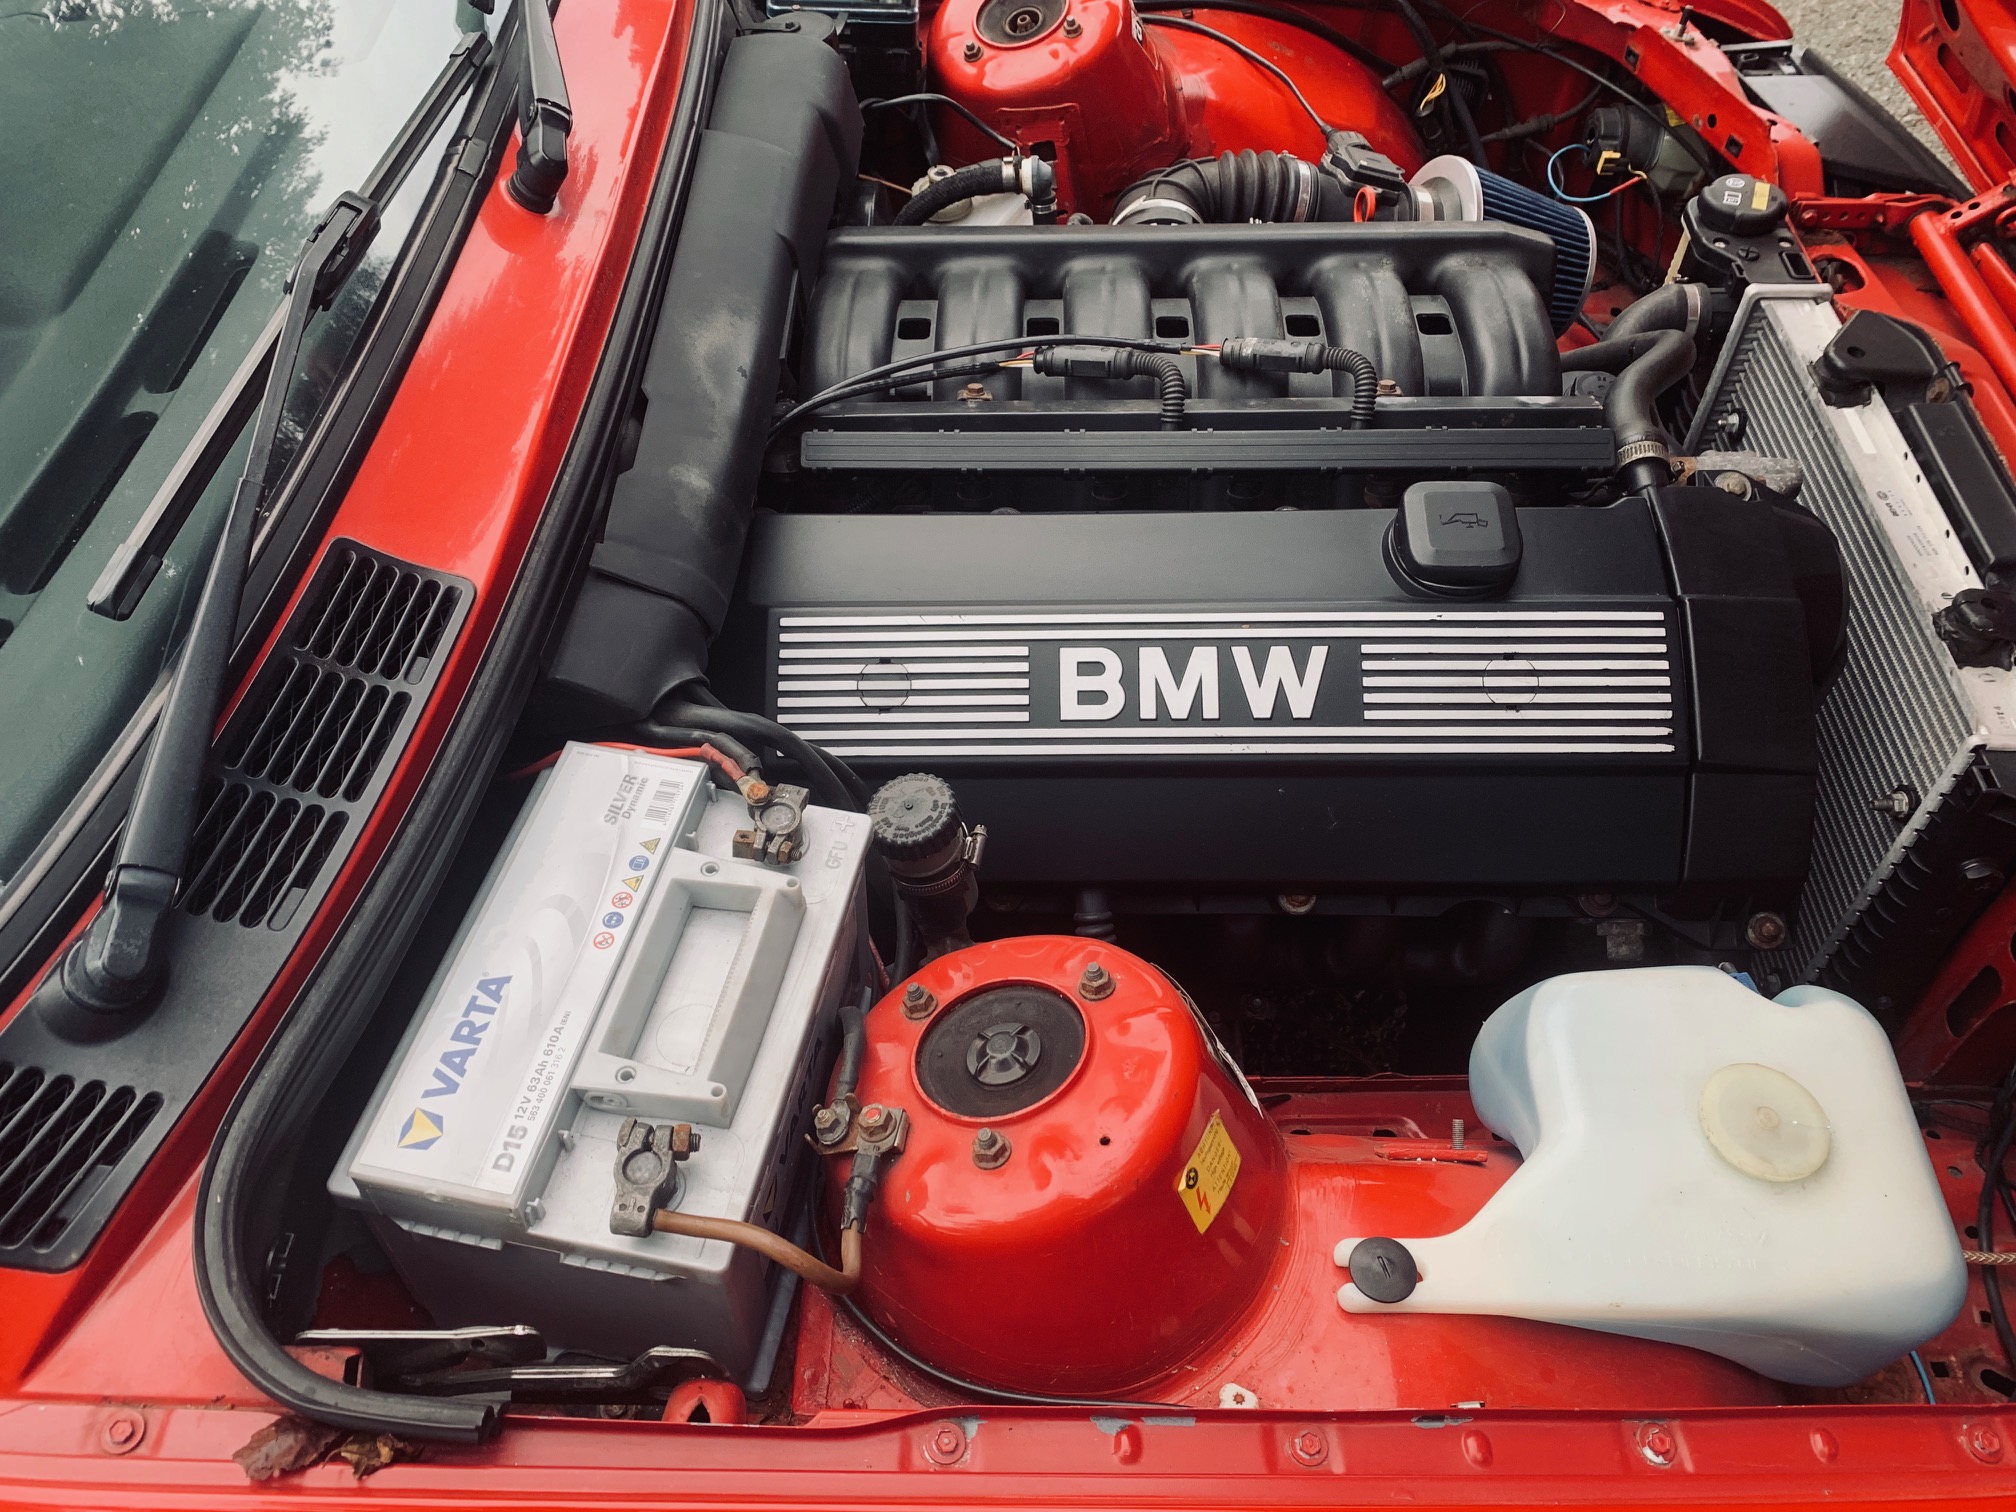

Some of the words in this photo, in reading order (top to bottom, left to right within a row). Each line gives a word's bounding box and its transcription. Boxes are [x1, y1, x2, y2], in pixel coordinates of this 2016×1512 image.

[1059, 645, 1330, 721] BMW
[603, 774, 638, 825] SILVER
[622, 777, 648, 819] Dynamic
[420, 975, 513, 1099] VARTA
[527, 1105, 541, 1122] 563
[535, 1087, 549, 1105] 400
[543, 1070, 556, 1087] 061
[550, 1053, 563, 1070] 316
[561, 1046, 567, 1054] 2
[491, 1123, 529, 1173] D15
[514, 1095, 532, 1120] 12V
